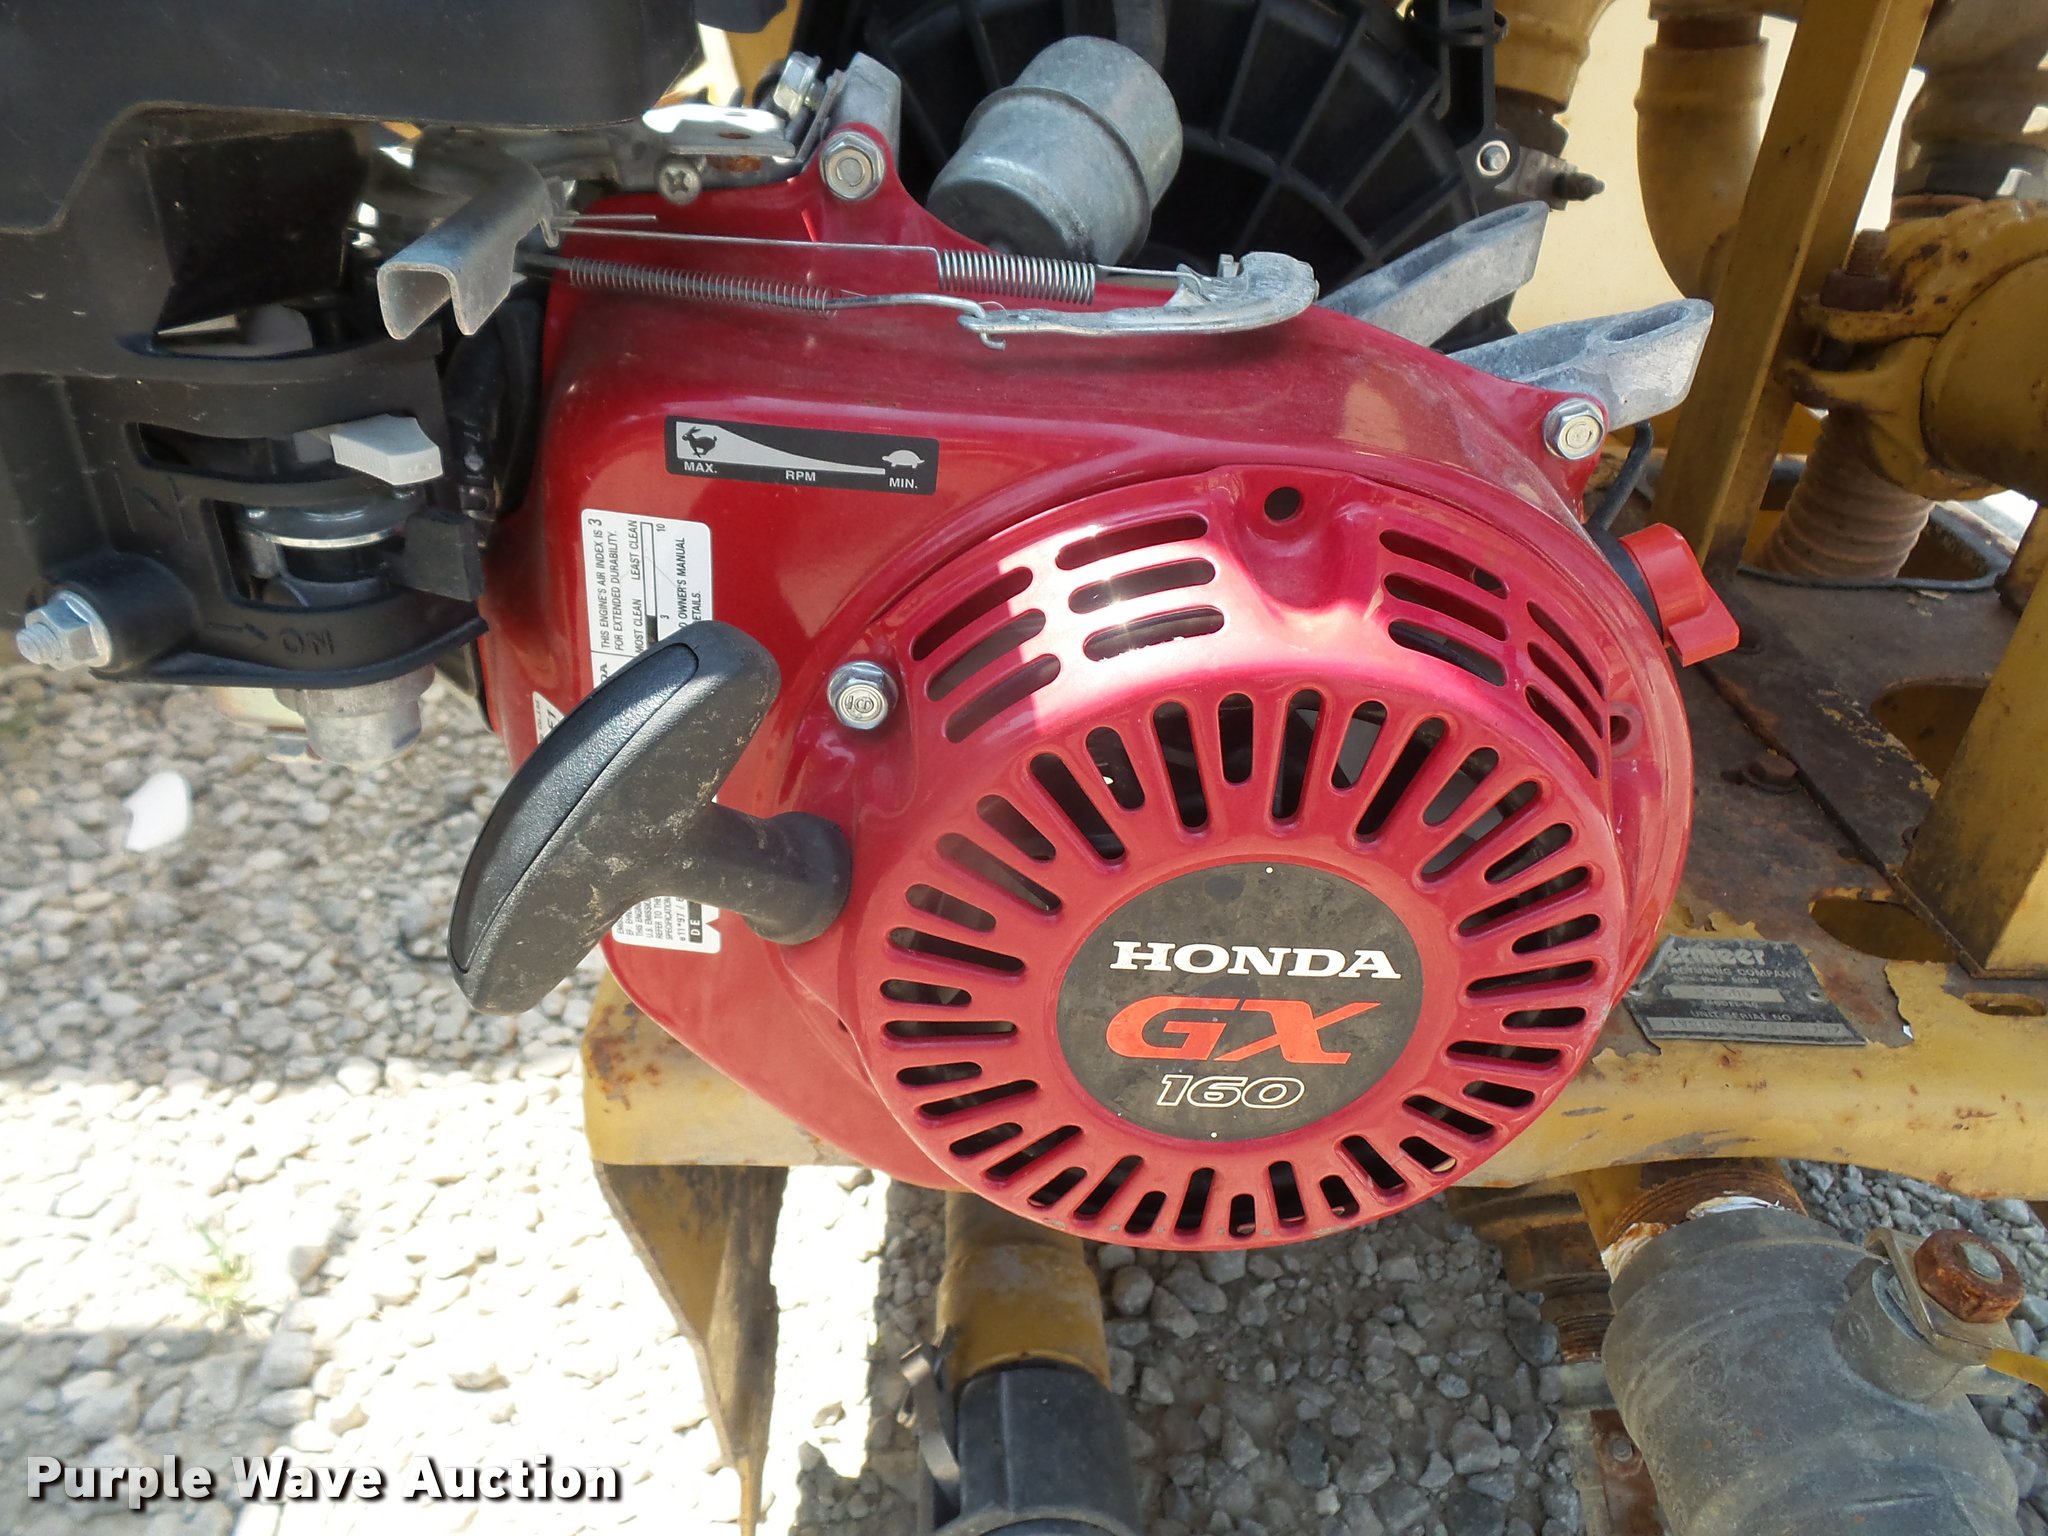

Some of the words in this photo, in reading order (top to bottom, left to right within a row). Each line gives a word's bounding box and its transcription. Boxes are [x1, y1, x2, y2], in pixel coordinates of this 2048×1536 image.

[684, 461, 718, 474] MAX.
[785, 470, 816, 482] RPM
[889, 477, 918, 489] MIN.
[593, 530, 602, 538] IS
[628, 520, 638, 549] CLEAN
[656, 524, 665, 532] 10
[594, 542, 604, 568] INDEX
[607, 531, 620, 583] DURABILITY.
[629, 553, 641, 580] LEAST
[675, 538, 685, 576] MANUAL
[597, 571, 606, 586] AIR
[597, 588, 608, 627] ENGINE'S
[610, 587, 622, 631] EXTENDED
[632, 599, 642, 626] CLEAN
[675, 580, 687, 619] OWNER'S
[692, 591, 701, 621] ETAILS.
[600, 629, 610, 648] THIS
[614, 635, 624, 651] FOR
[633, 630, 643, 653] MOST
[665, 897, 673, 940] SPECIFICATION
[1109, 940, 1403, 979] HONDA
[1665, 946, 1765, 966] ermeer
[1106, 995, 1382, 1065] GX
[1156, 1074, 1305, 1110] 160
